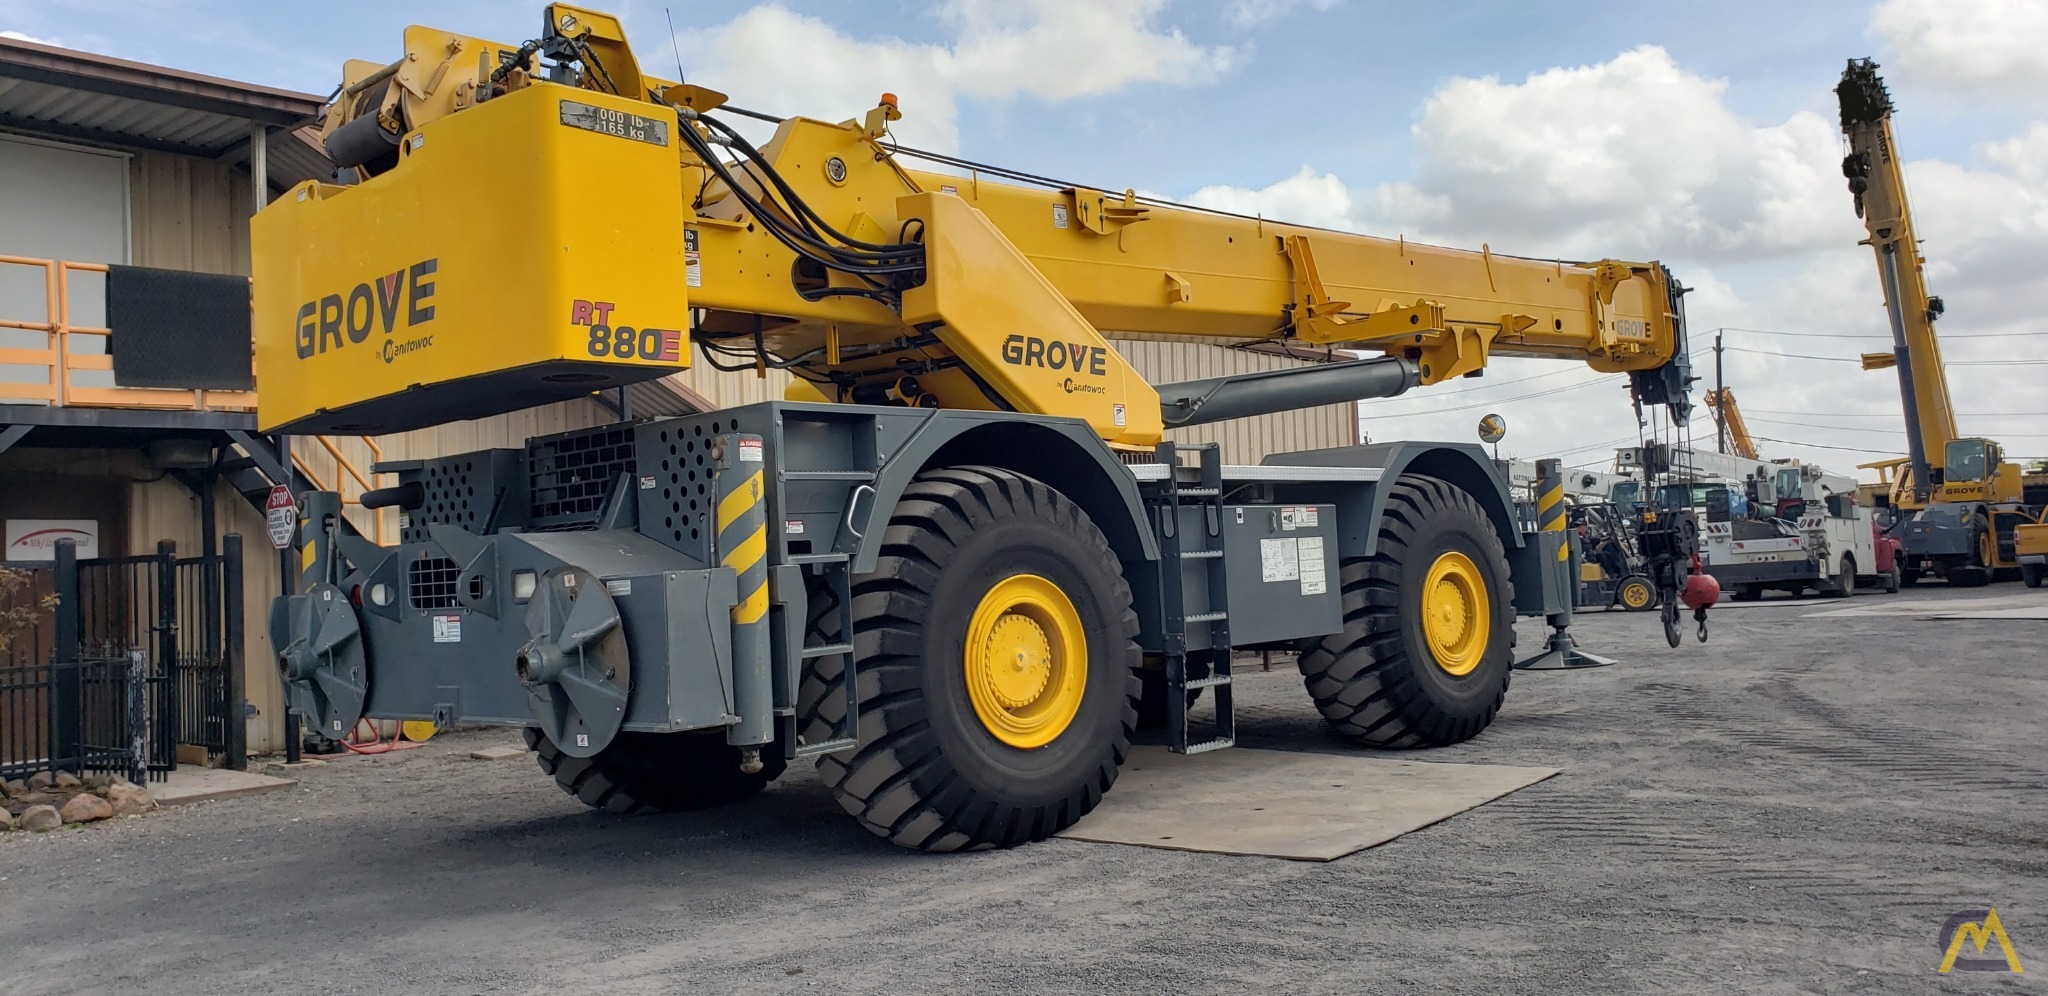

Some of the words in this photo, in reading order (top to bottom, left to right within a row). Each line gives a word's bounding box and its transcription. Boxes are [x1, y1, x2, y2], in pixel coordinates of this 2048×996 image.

[630, 126, 645, 141] kg
[1876, 130, 1889, 166] GROVE
[295, 257, 438, 361] GROVE
[571, 299, 615, 326] RT
[1616, 319, 1651, 338] GROVE
[375, 351, 382, 361] by
[383, 335, 434, 364] Manitowoc
[587, 324, 681, 362] 880E
[1002, 334, 1107, 376] GROVE
[1063, 377, 1105, 395] Manitowoc
[272, 491, 288, 506] STOP
[1945, 486, 1984, 495] GROVE
